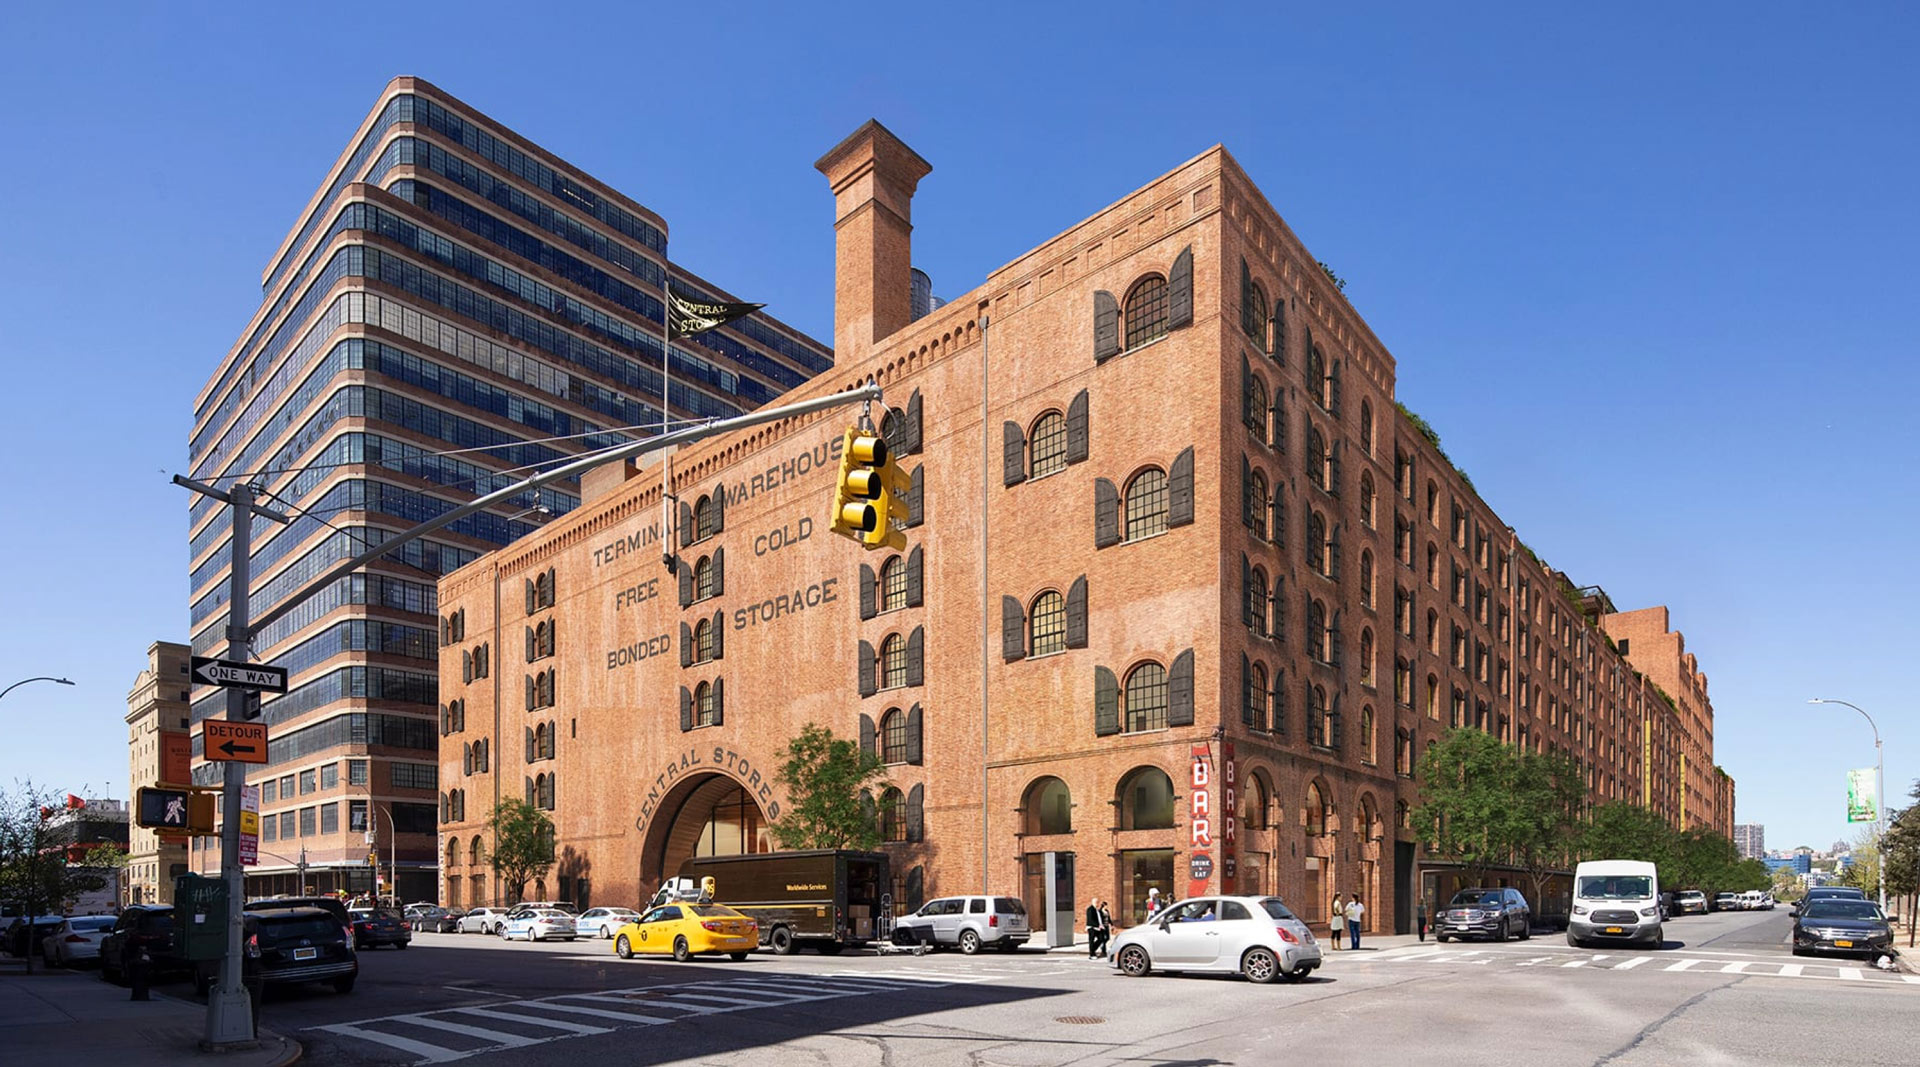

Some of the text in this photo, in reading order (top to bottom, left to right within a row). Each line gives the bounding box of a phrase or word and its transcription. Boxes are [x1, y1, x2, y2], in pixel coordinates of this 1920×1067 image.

[681, 317, 726, 332] STO
[593, 435, 845, 568] TERMINA WAREHOUS
[754, 516, 813, 557] COLD
[616, 577, 659, 611] FREE
[734, 577, 838, 631] STORAGE
[607, 633, 671, 671] BONDED
[209, 666, 274, 684] ONE WAY
[209, 725, 262, 739] DETOUR
[636, 746, 780, 832] CENTRAL STORES
[1193, 762, 1209, 842] BAR
[1226, 760, 1235, 841] BAR
